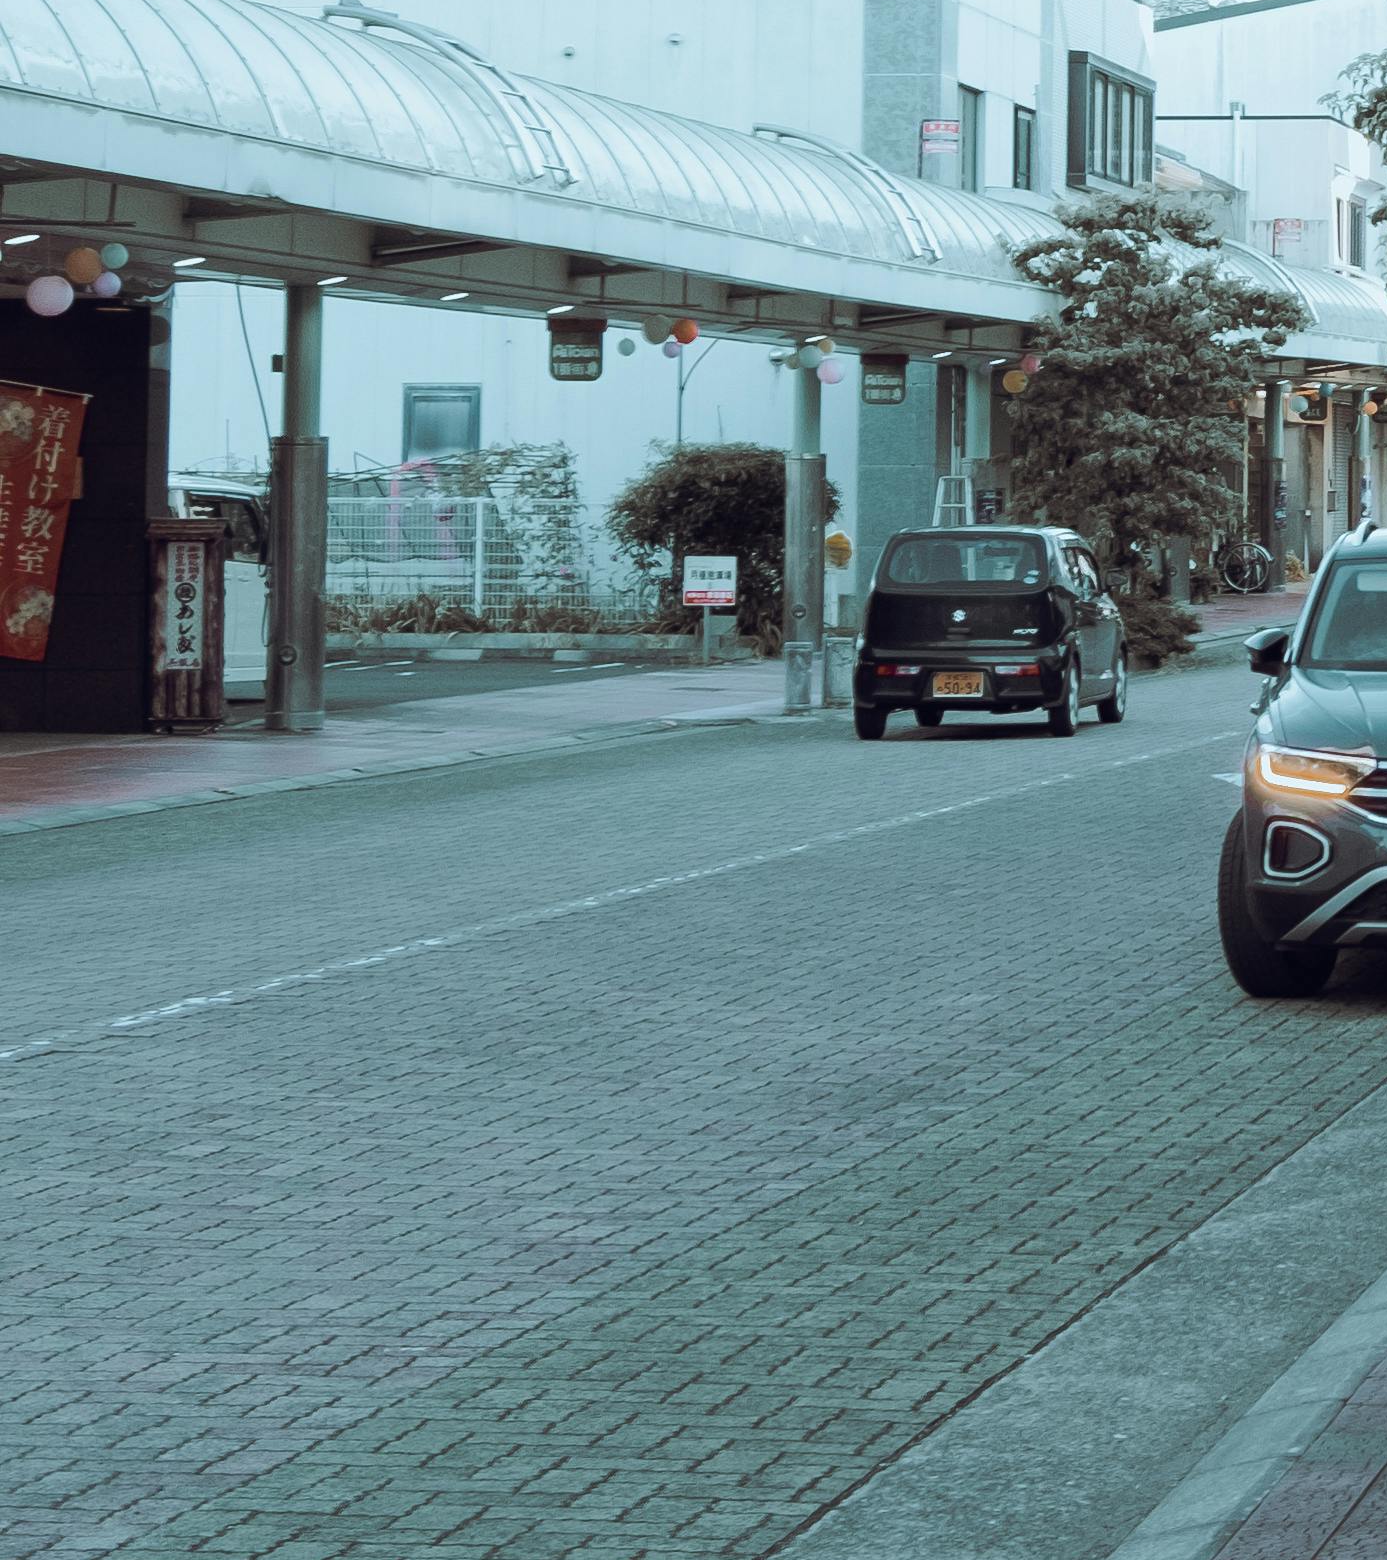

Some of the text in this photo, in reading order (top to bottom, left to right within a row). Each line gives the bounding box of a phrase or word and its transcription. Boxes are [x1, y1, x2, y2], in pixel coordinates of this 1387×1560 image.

[15, 405, 72, 576] 着付け教室
